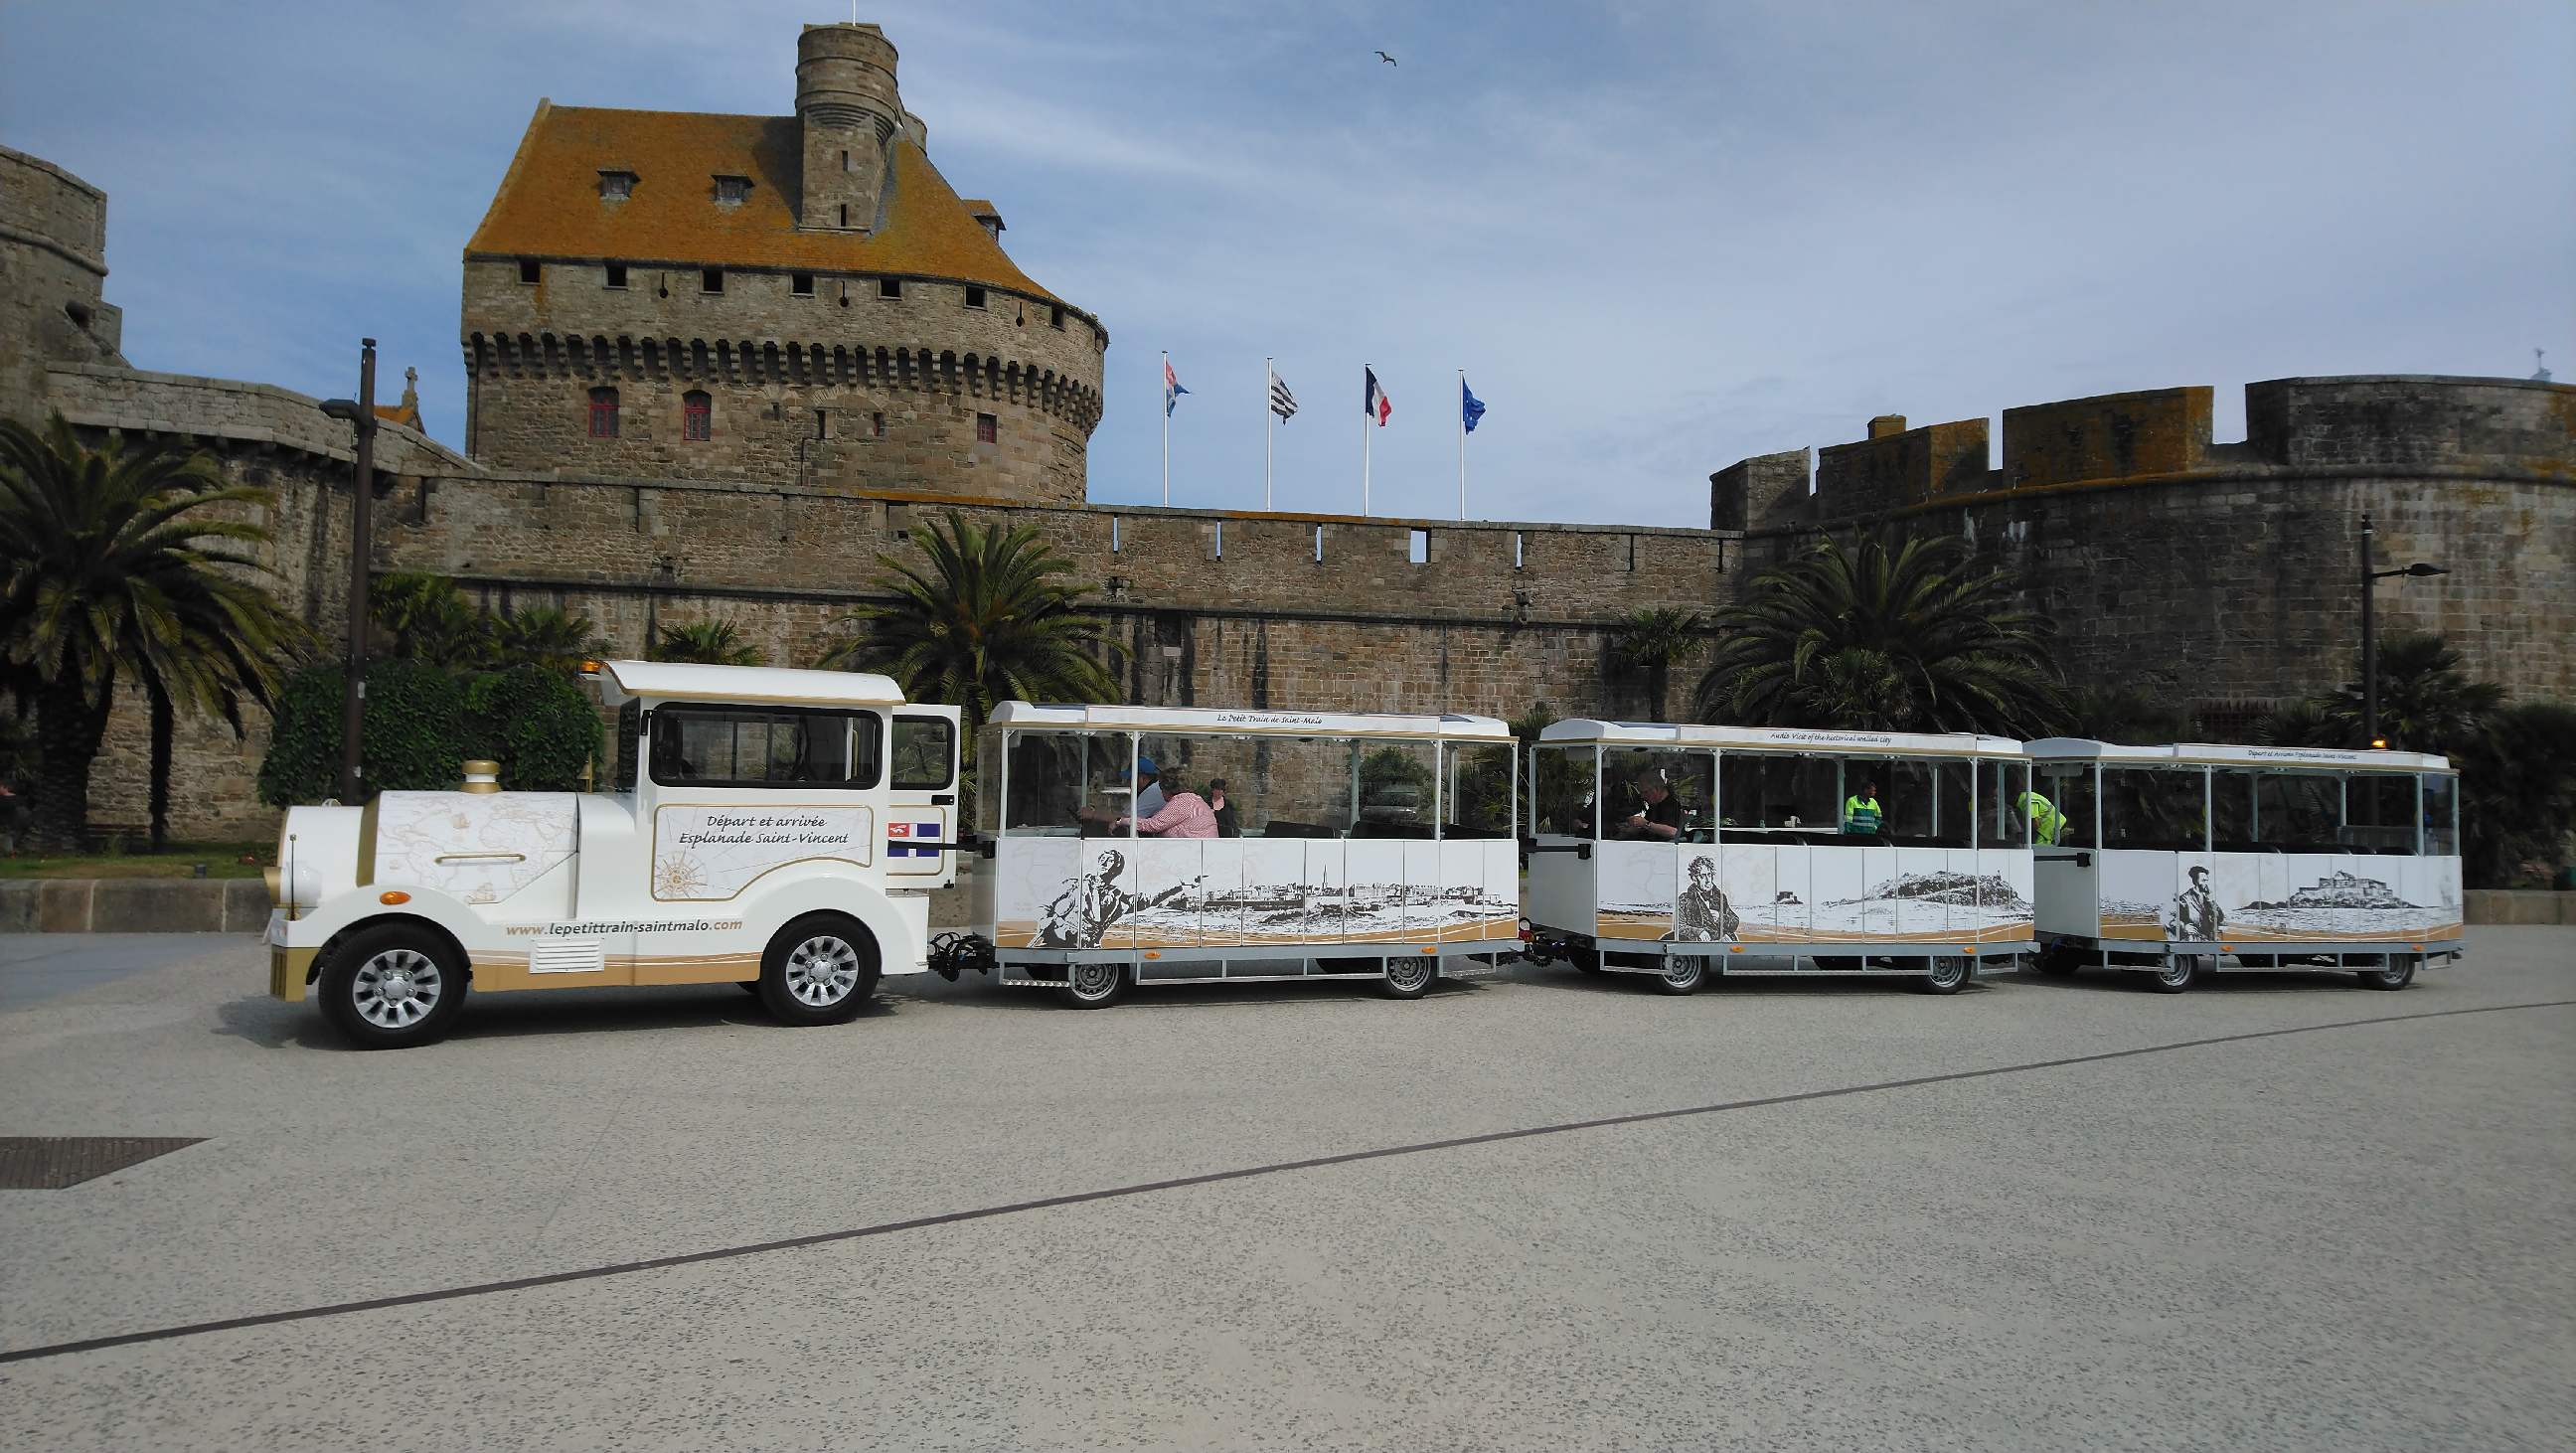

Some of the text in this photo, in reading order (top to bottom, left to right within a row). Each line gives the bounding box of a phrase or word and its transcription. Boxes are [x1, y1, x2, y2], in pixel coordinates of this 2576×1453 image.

[1228, 714, 1246, 723] Petit
[1271, 715, 1279, 724] de
[1280, 715, 1323, 725] Saint-Malo
[1807, 733, 1814, 744] of
[1813, 732, 1826, 741] the
[1826, 733, 1855, 742] historical
[706, 814, 827, 830] Départ et arrivée
[679, 831, 850, 849] Esplanade Saint-Vincent
[506, 919, 742, 937] www.lepetittrain-saintmalo.com
